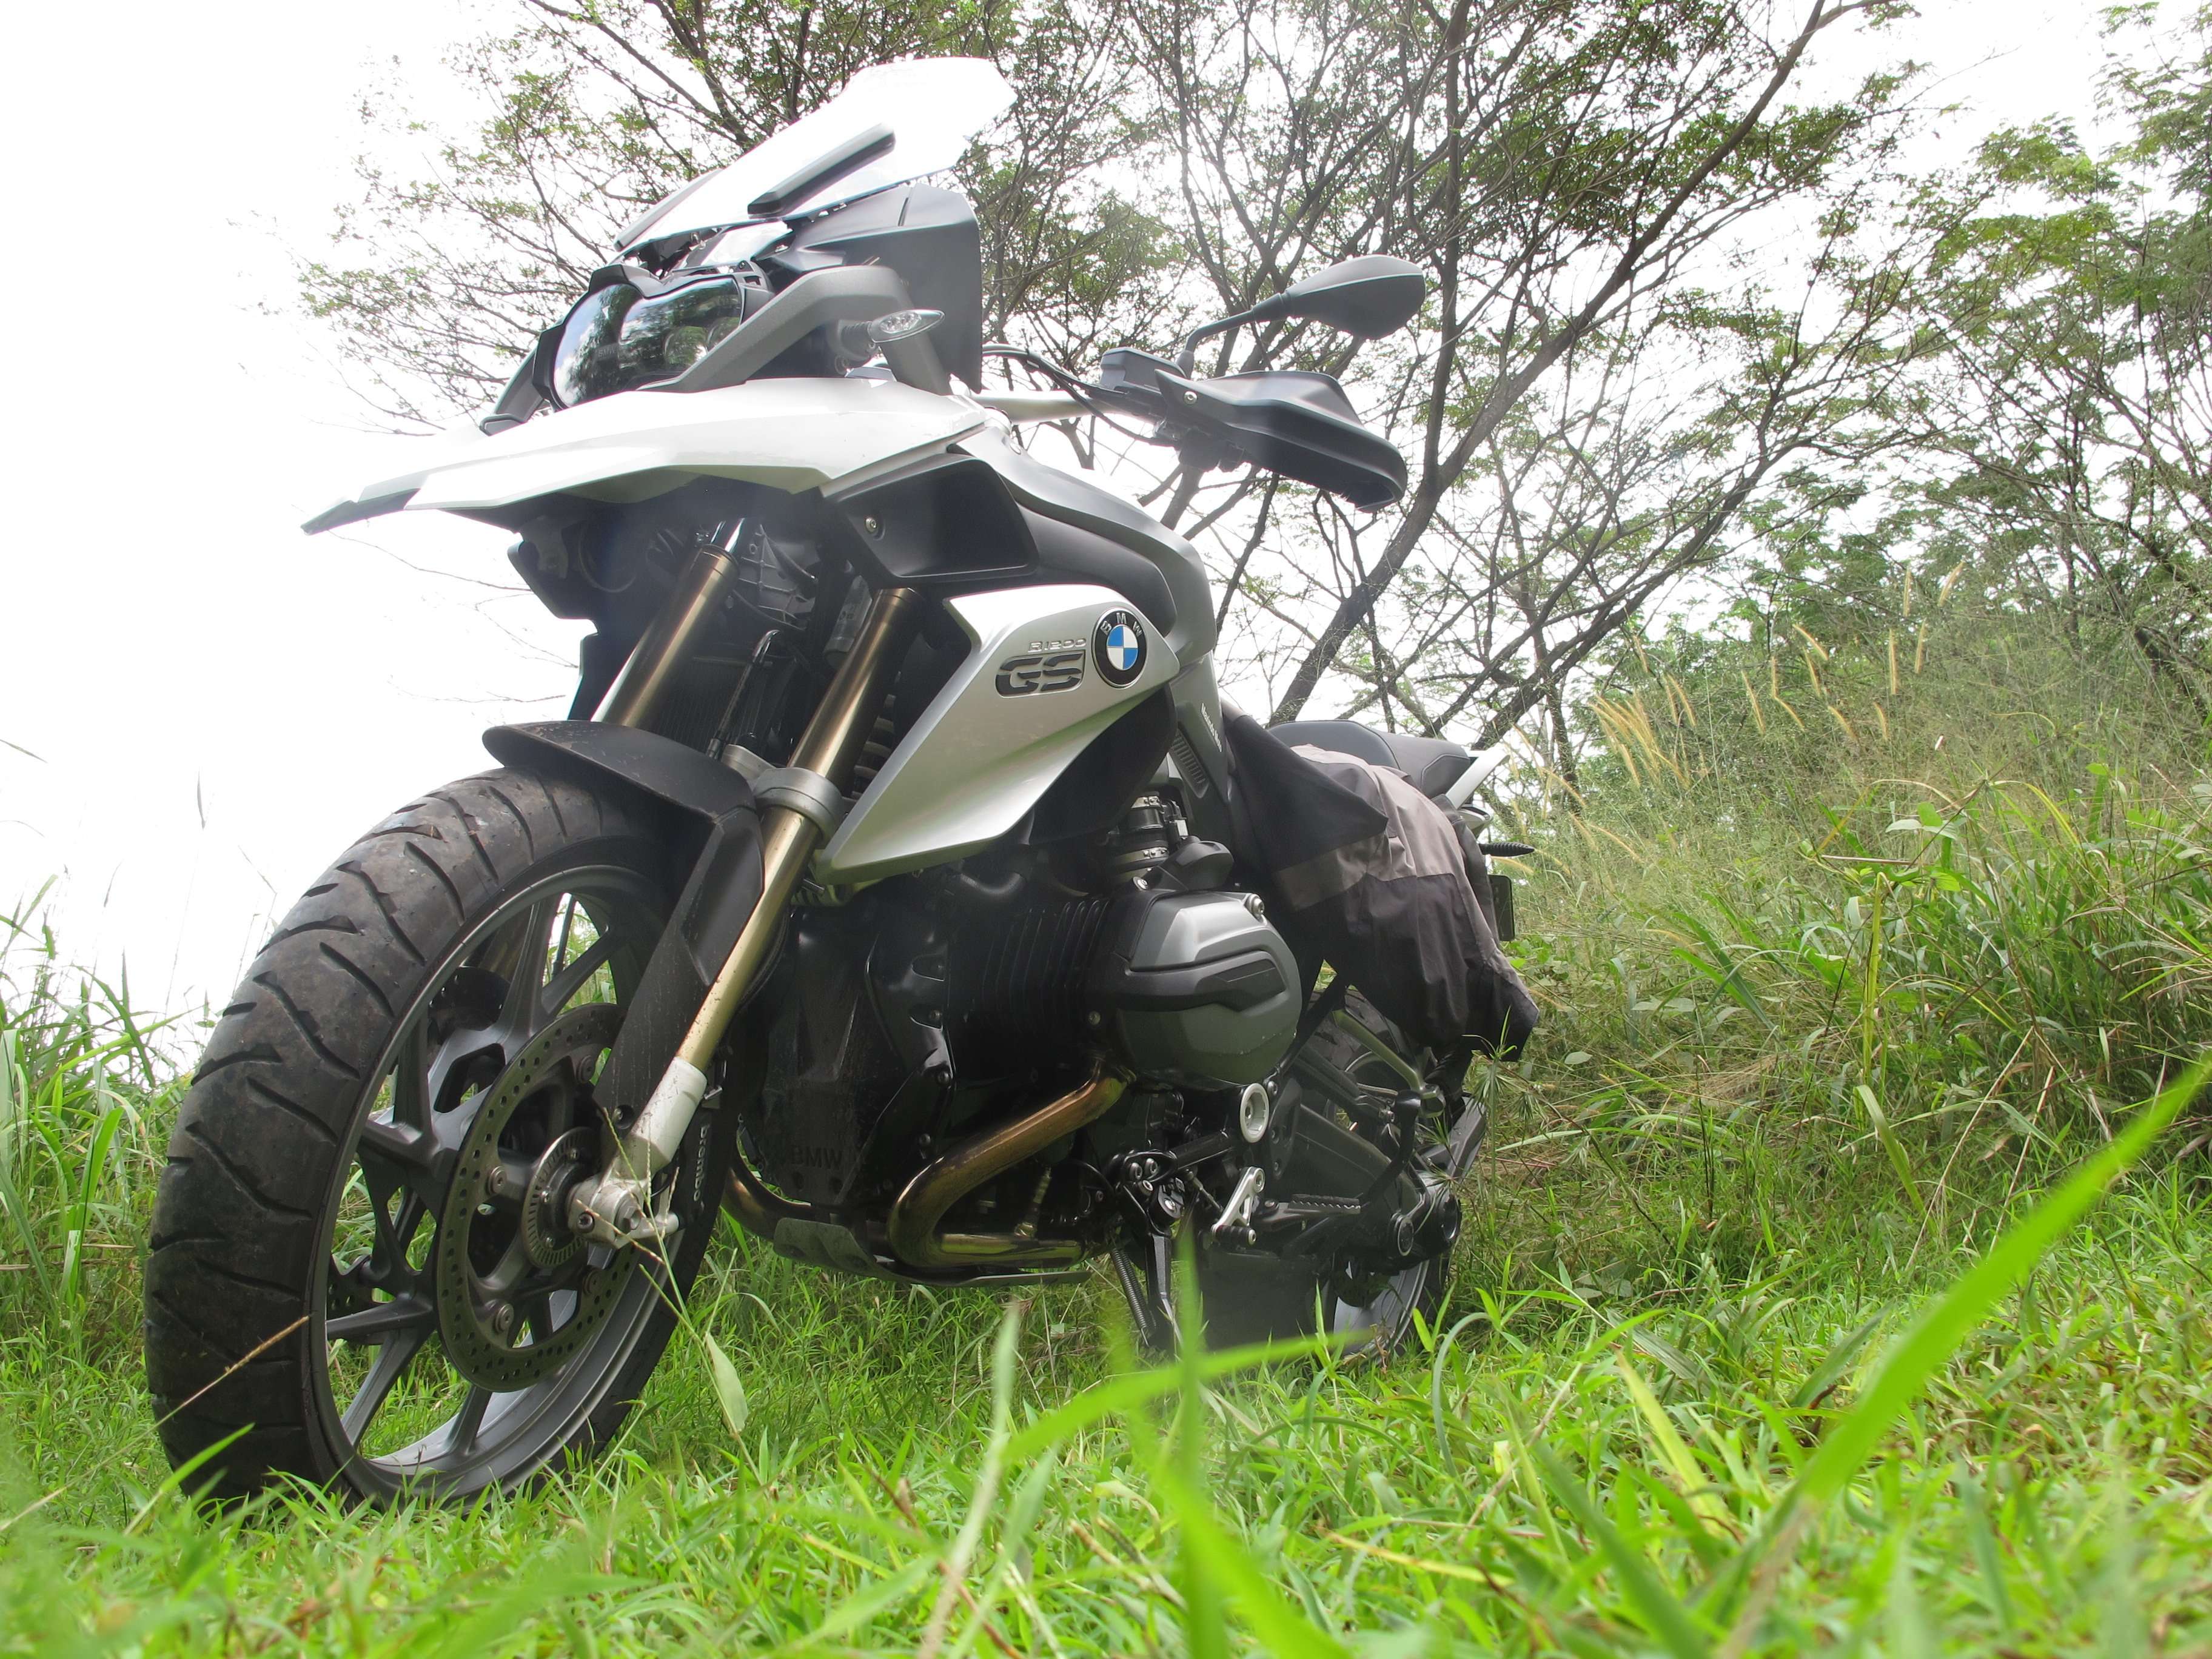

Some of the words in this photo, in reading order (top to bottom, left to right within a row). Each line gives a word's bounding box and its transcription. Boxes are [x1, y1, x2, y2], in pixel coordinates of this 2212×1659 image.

[1099, 612, 1143, 635] BMW
[996, 653, 1083, 695] GS
[694, 1124, 710, 1202] brembo
[791, 1146, 842, 1169] BMW
